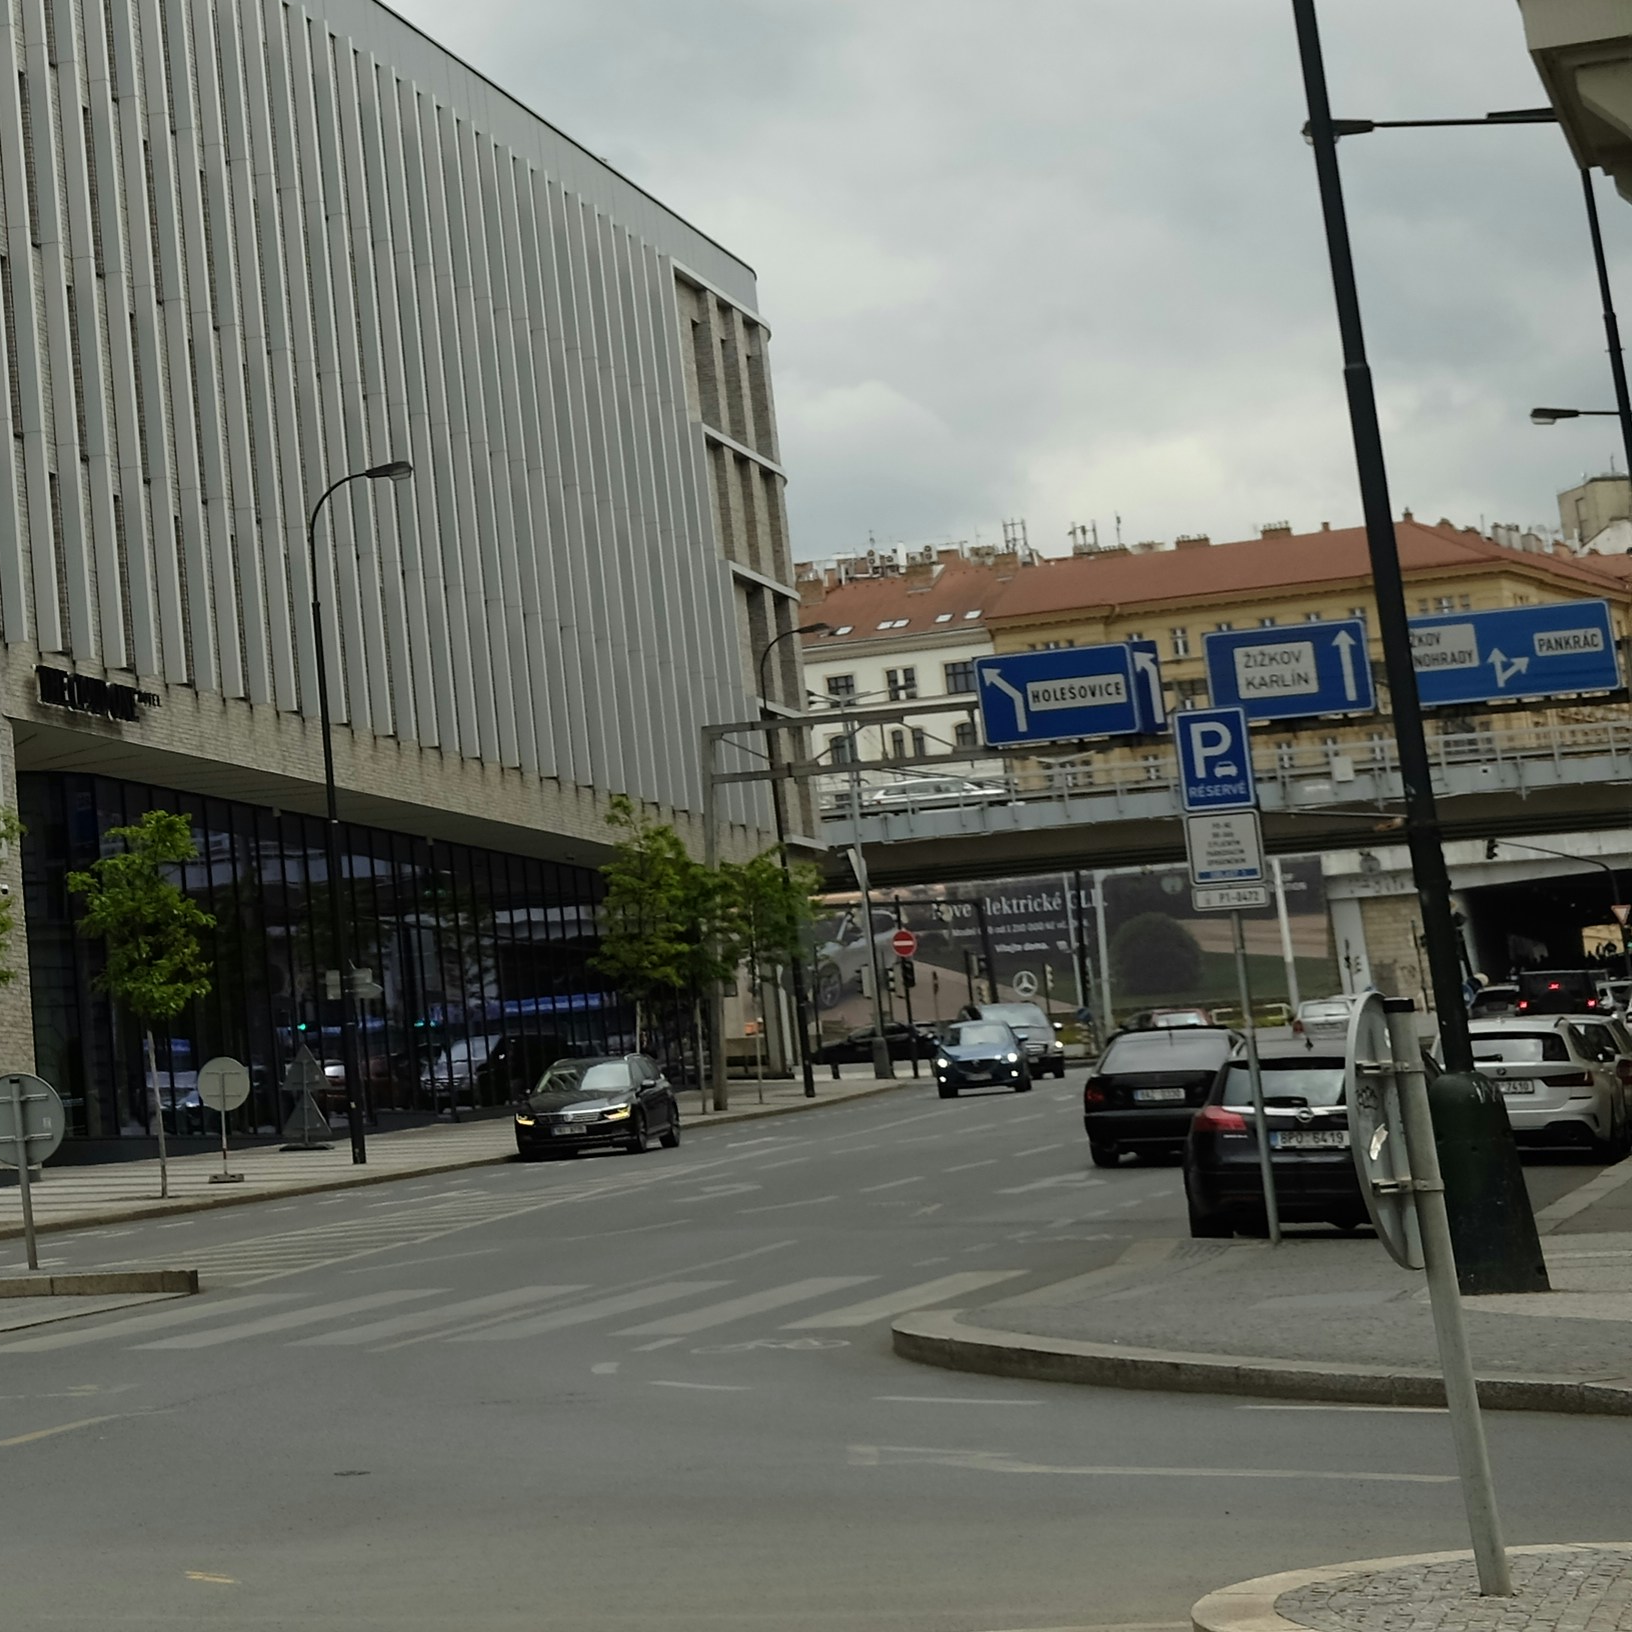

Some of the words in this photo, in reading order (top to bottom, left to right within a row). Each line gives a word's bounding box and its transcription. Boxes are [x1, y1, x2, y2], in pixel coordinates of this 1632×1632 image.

[1537, 629, 1600, 652] PANKRÁC
[1243, 648, 1302, 669] ŽIŽKOV
[1413, 648, 1474, 668] NOHRADY
[1245, 668, 1310, 690] KARLÍN
[1031, 681, 1123, 703] HOLEŠOVICE
[1189, 721, 1232, 779] P
[1188, 779, 1247, 798] RÉSERVÉ
[983, 892, 1062, 915] lektrické
